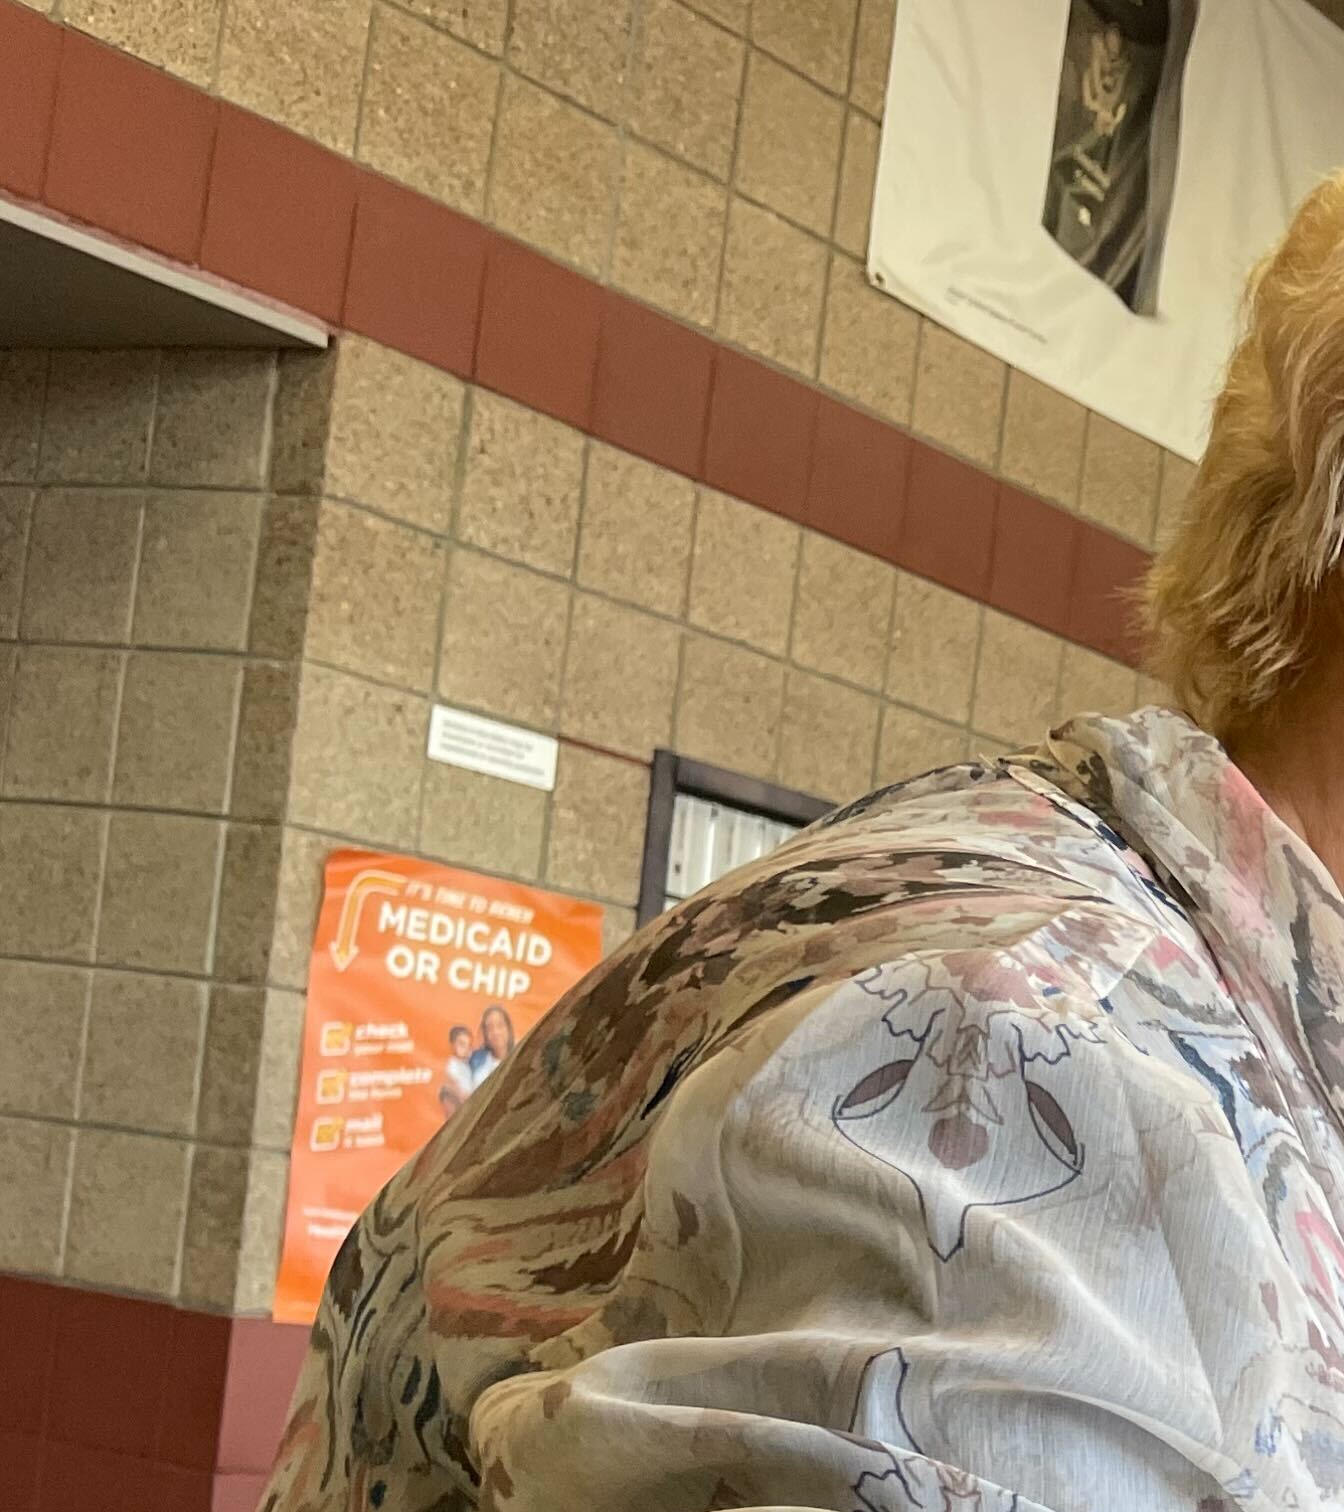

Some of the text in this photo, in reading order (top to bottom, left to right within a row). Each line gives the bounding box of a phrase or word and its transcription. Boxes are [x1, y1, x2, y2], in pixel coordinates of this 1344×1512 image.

[377, 901, 553, 967] MEDICAID
[386, 944, 531, 1000] OR CHIP
